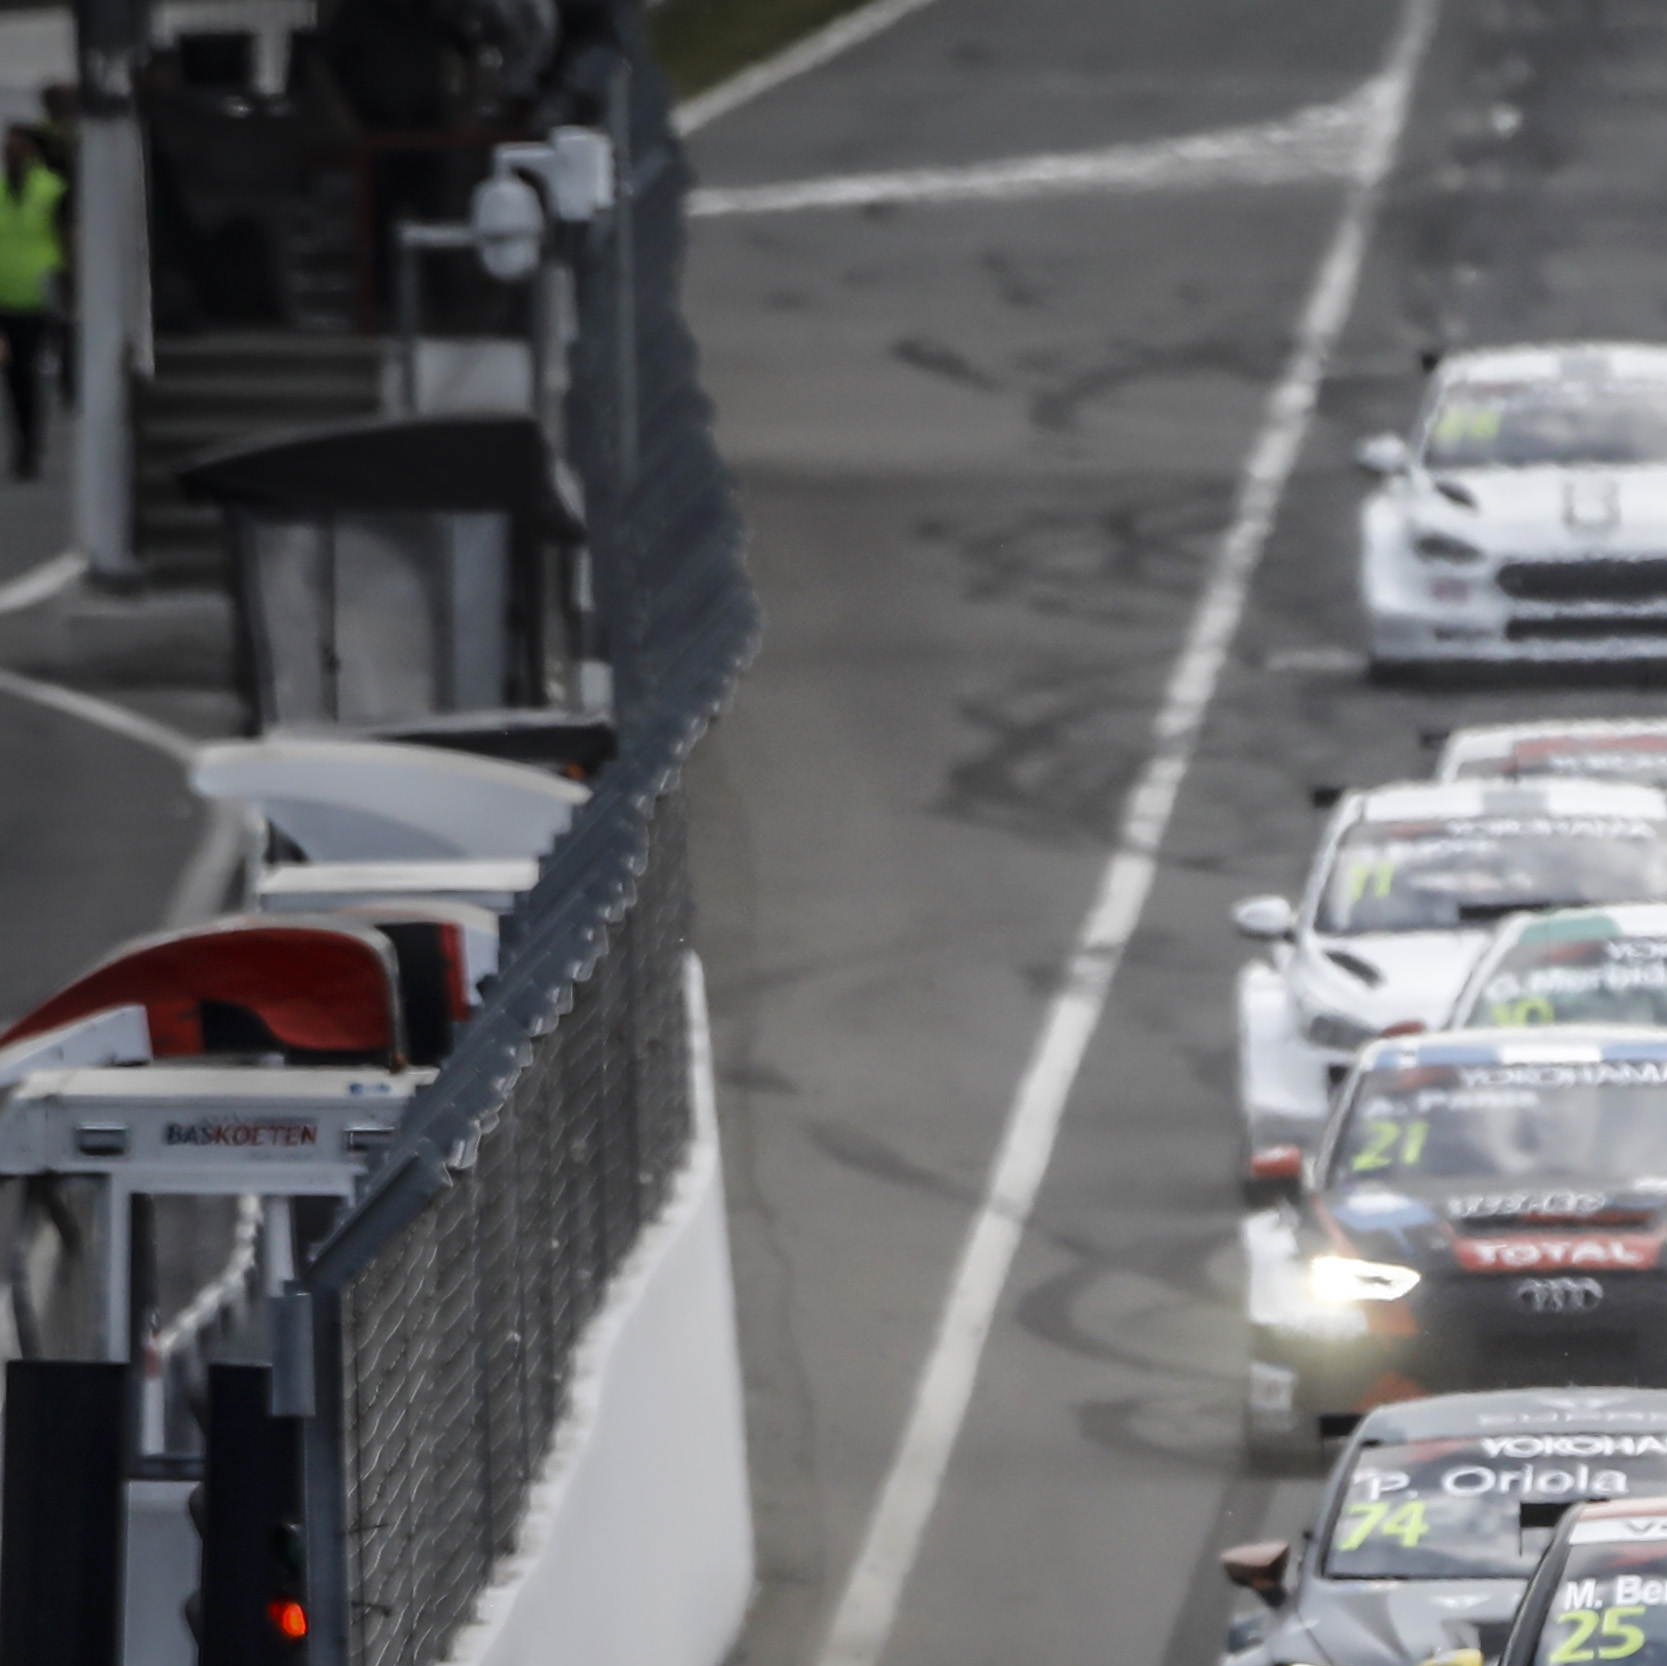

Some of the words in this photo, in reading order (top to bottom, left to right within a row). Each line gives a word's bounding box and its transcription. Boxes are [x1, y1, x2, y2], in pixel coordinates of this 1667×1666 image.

[1353, 1120, 1430, 1172] 21
[1475, 1241, 1645, 1266] TOTAL
[1442, 1464, 1628, 1495] Oriola
[1339, 1502, 1430, 1551] 74
[1564, 1580, 1602, 1609] M.
[1549, 1606, 1646, 1665] 25
